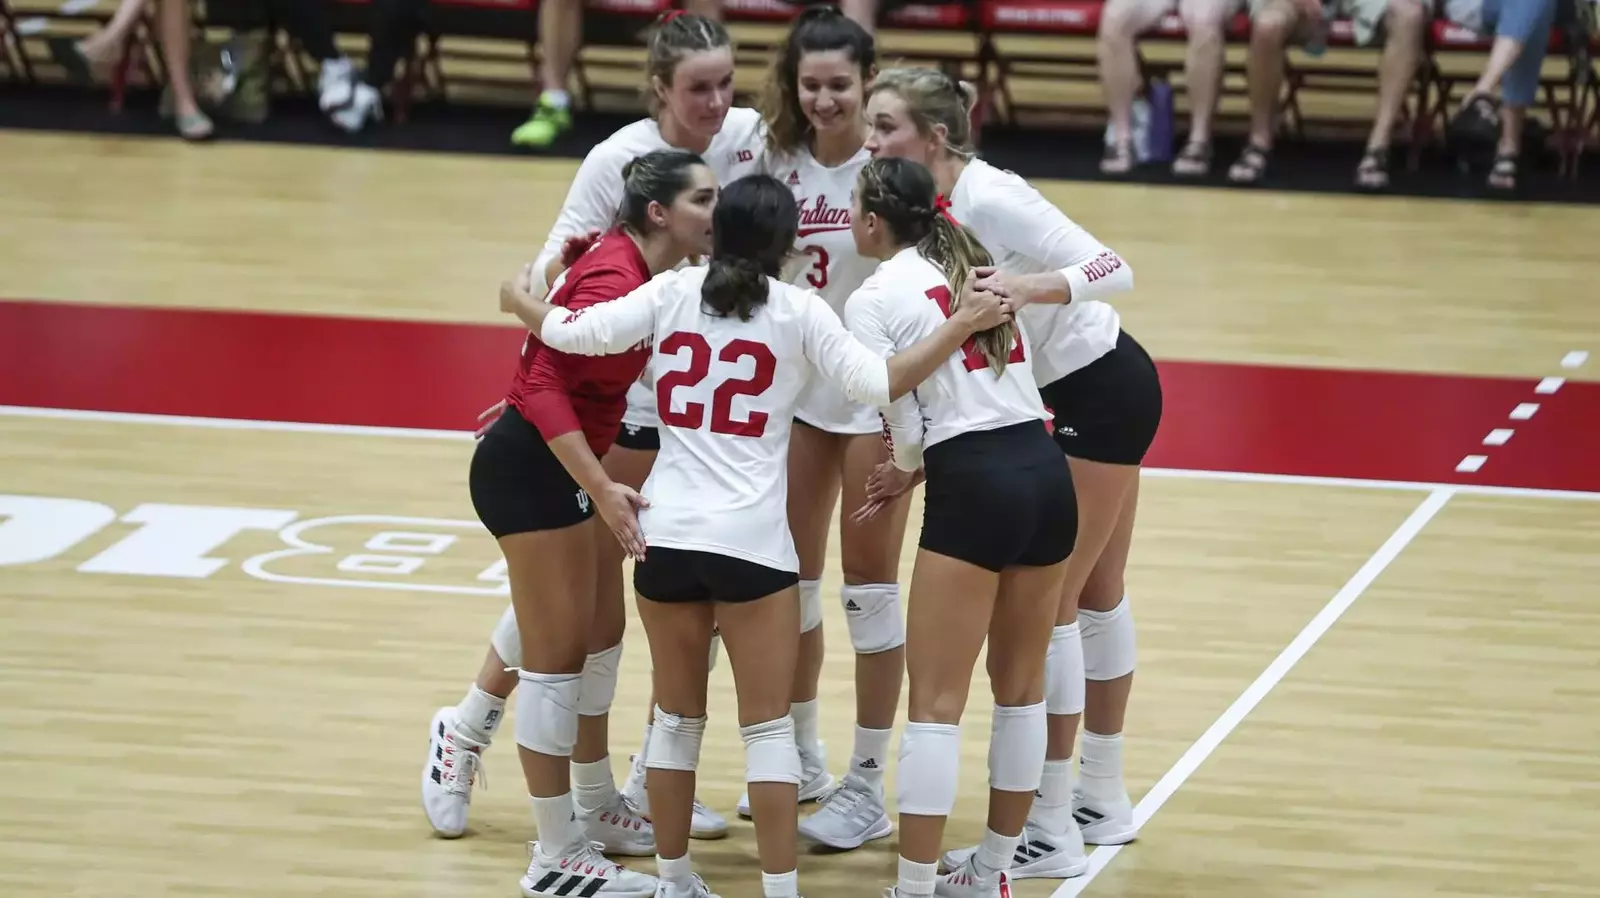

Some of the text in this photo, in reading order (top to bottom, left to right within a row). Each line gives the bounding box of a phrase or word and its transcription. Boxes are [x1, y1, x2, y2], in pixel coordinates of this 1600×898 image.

[796, 194, 851, 225] Indian
[803, 245, 829, 289] 3
[656, 330, 777, 438] 22
